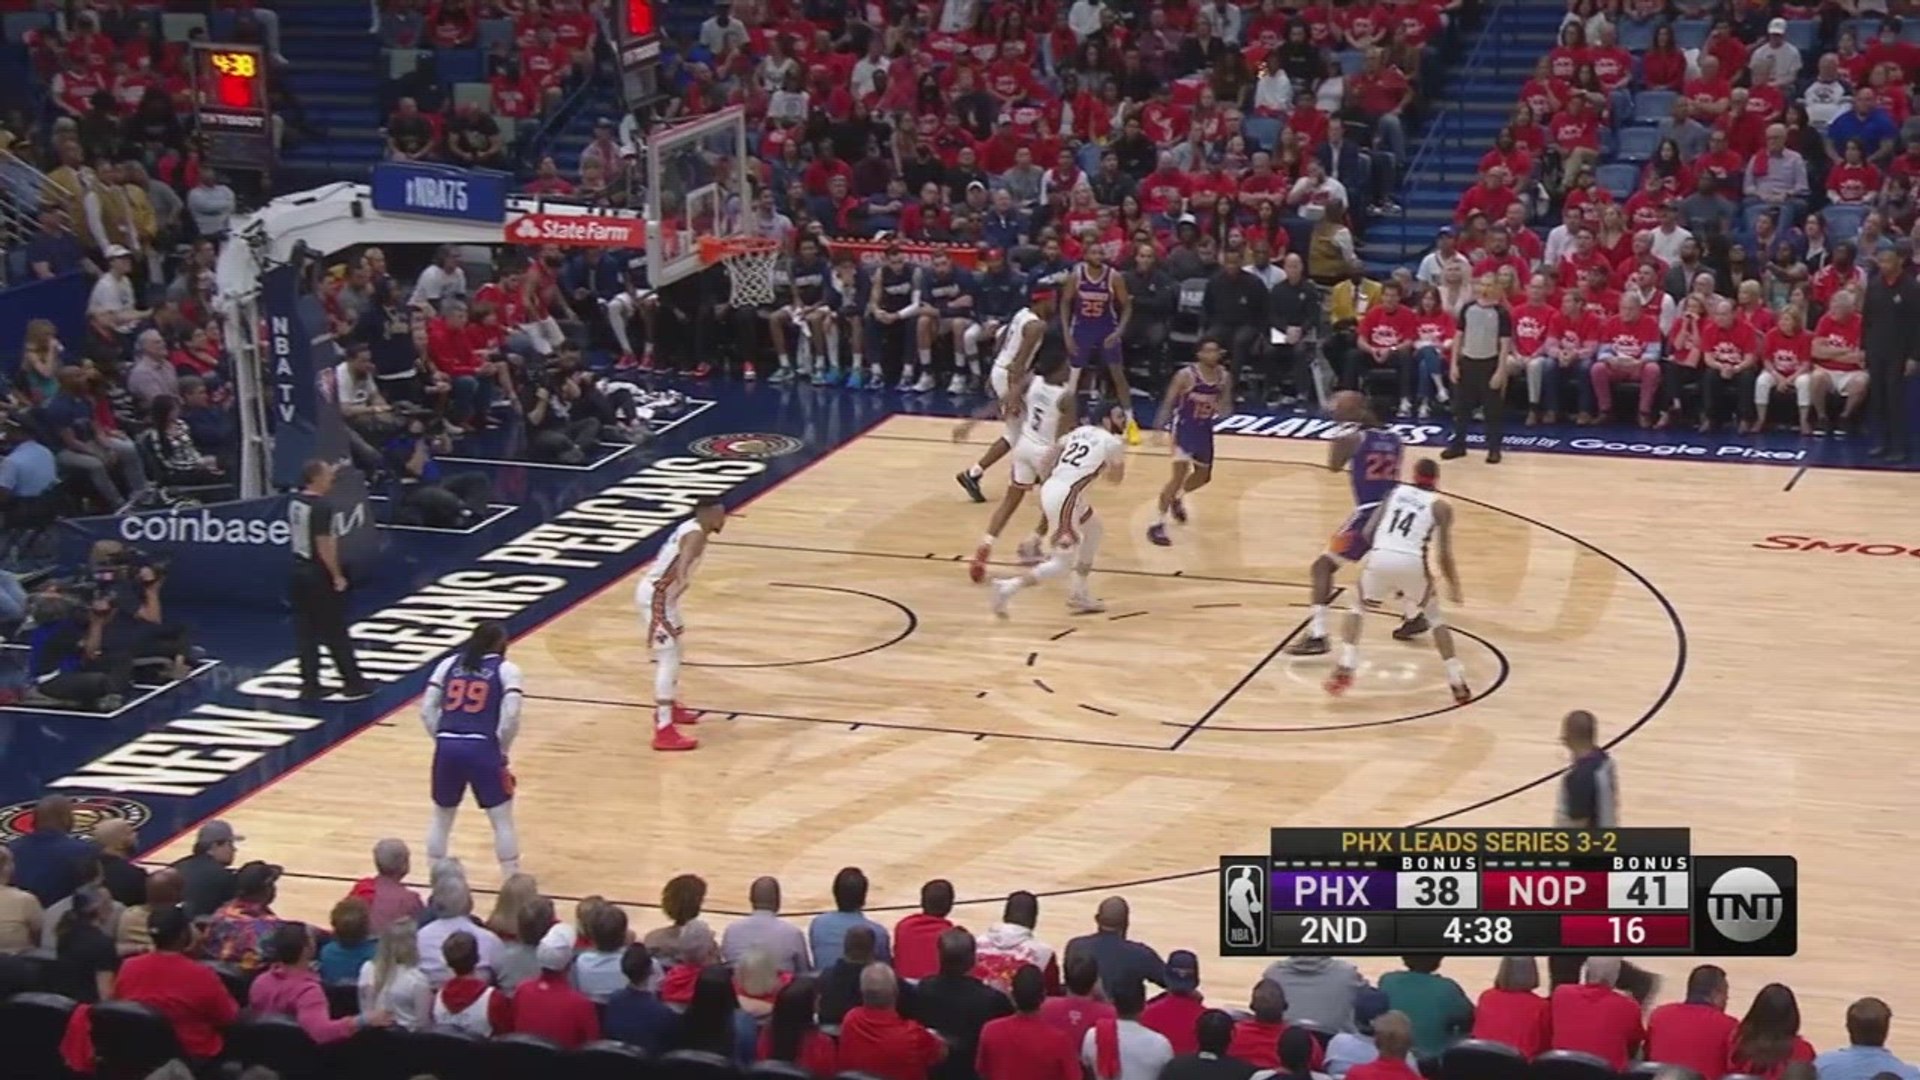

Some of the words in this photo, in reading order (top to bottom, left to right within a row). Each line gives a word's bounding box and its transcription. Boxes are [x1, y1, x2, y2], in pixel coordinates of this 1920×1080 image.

[272, 316, 293, 376] NBA
[278, 384, 296, 422] TV
[1061, 442, 1090, 468] 22
[1570, 438, 1707, 456] Google
[1716, 444, 1806, 461] Pixel
[121, 510, 290, 545] coinbase
[1387, 508, 1417, 537] 14
[47, 705, 324, 795] NEW
[477, 457, 768, 568] PELICANS
[443, 679, 490, 713] 99
